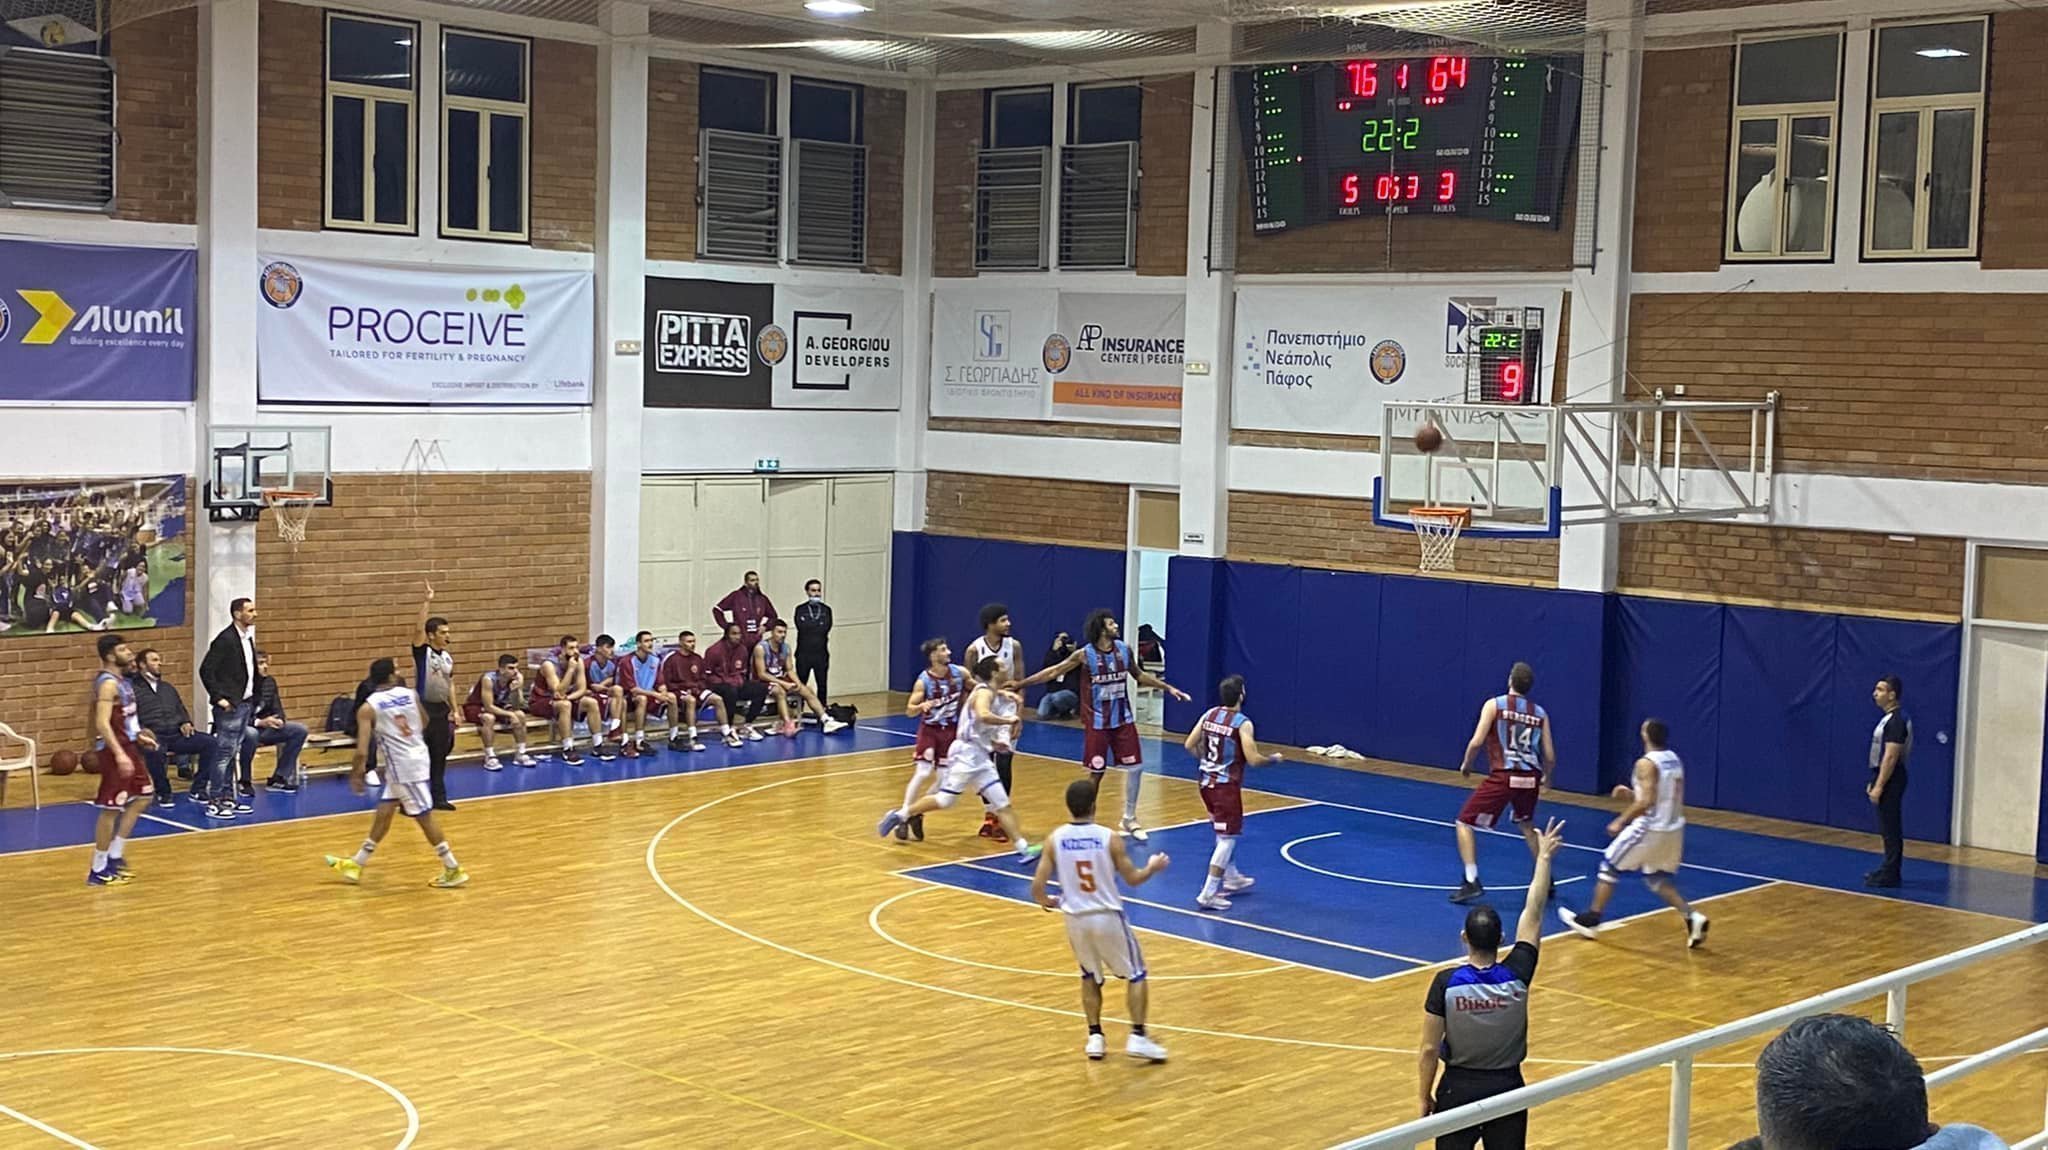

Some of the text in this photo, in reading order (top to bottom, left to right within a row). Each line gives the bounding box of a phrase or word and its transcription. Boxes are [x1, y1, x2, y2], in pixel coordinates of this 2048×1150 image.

[1347, 63, 1377, 97] 76
[1432, 57, 1467, 92] 64
[1363, 117, 1420, 152] 22:2
[1484, 127, 1496, 138] 10
[1254, 145, 1265, 156] 10
[1482, 140, 1494, 152] 11
[1255, 158, 1265, 169] 11
[1481, 154, 1494, 165] 12
[1255, 170, 1266, 182] 12
[1480, 168, 1493, 179] 13
[1345, 175, 1359, 203] 5
[1440, 172, 1455, 200] 3
[1477, 194, 1490, 206] 15
[1257, 208, 1268, 219] 15
[1385, 206, 1409, 214] PAYER
[72, 305, 184, 335] Alumil
[328, 306, 526, 346] PROCEIVE
[660, 314, 747, 347] PITTA
[1267, 329, 1366, 348] Πανεπιστήμιο
[70, 336, 184, 349] Building excellence every day
[805, 336, 890, 352] A. GEORGIOU
[1102, 337, 1184, 353] INSURANCE
[330, 349, 526, 363] TAILORED FOR FERTILITY & PREGNANCY
[660, 345, 748, 369] EXPRESS
[805, 354, 890, 368] DEVELOPERS
[1101, 353, 1184, 364] CENTER PEGEIA
[1265, 350, 1333, 369] Νεάπολις
[960, 366, 1039, 384] ΓΕΩΡΓΙΑΔΗΣ
[1265, 370, 1313, 388] Πάφος
[1502, 364, 1520, 397] 9
[1075, 389, 1090, 398] ALL
[1092, 390, 1111, 399] KIND
[1113, 390, 1124, 399] OF
[1509, 724, 1532, 752] 14
[1208, 735, 1220, 762] 5
[1075, 860, 1097, 893] 5
